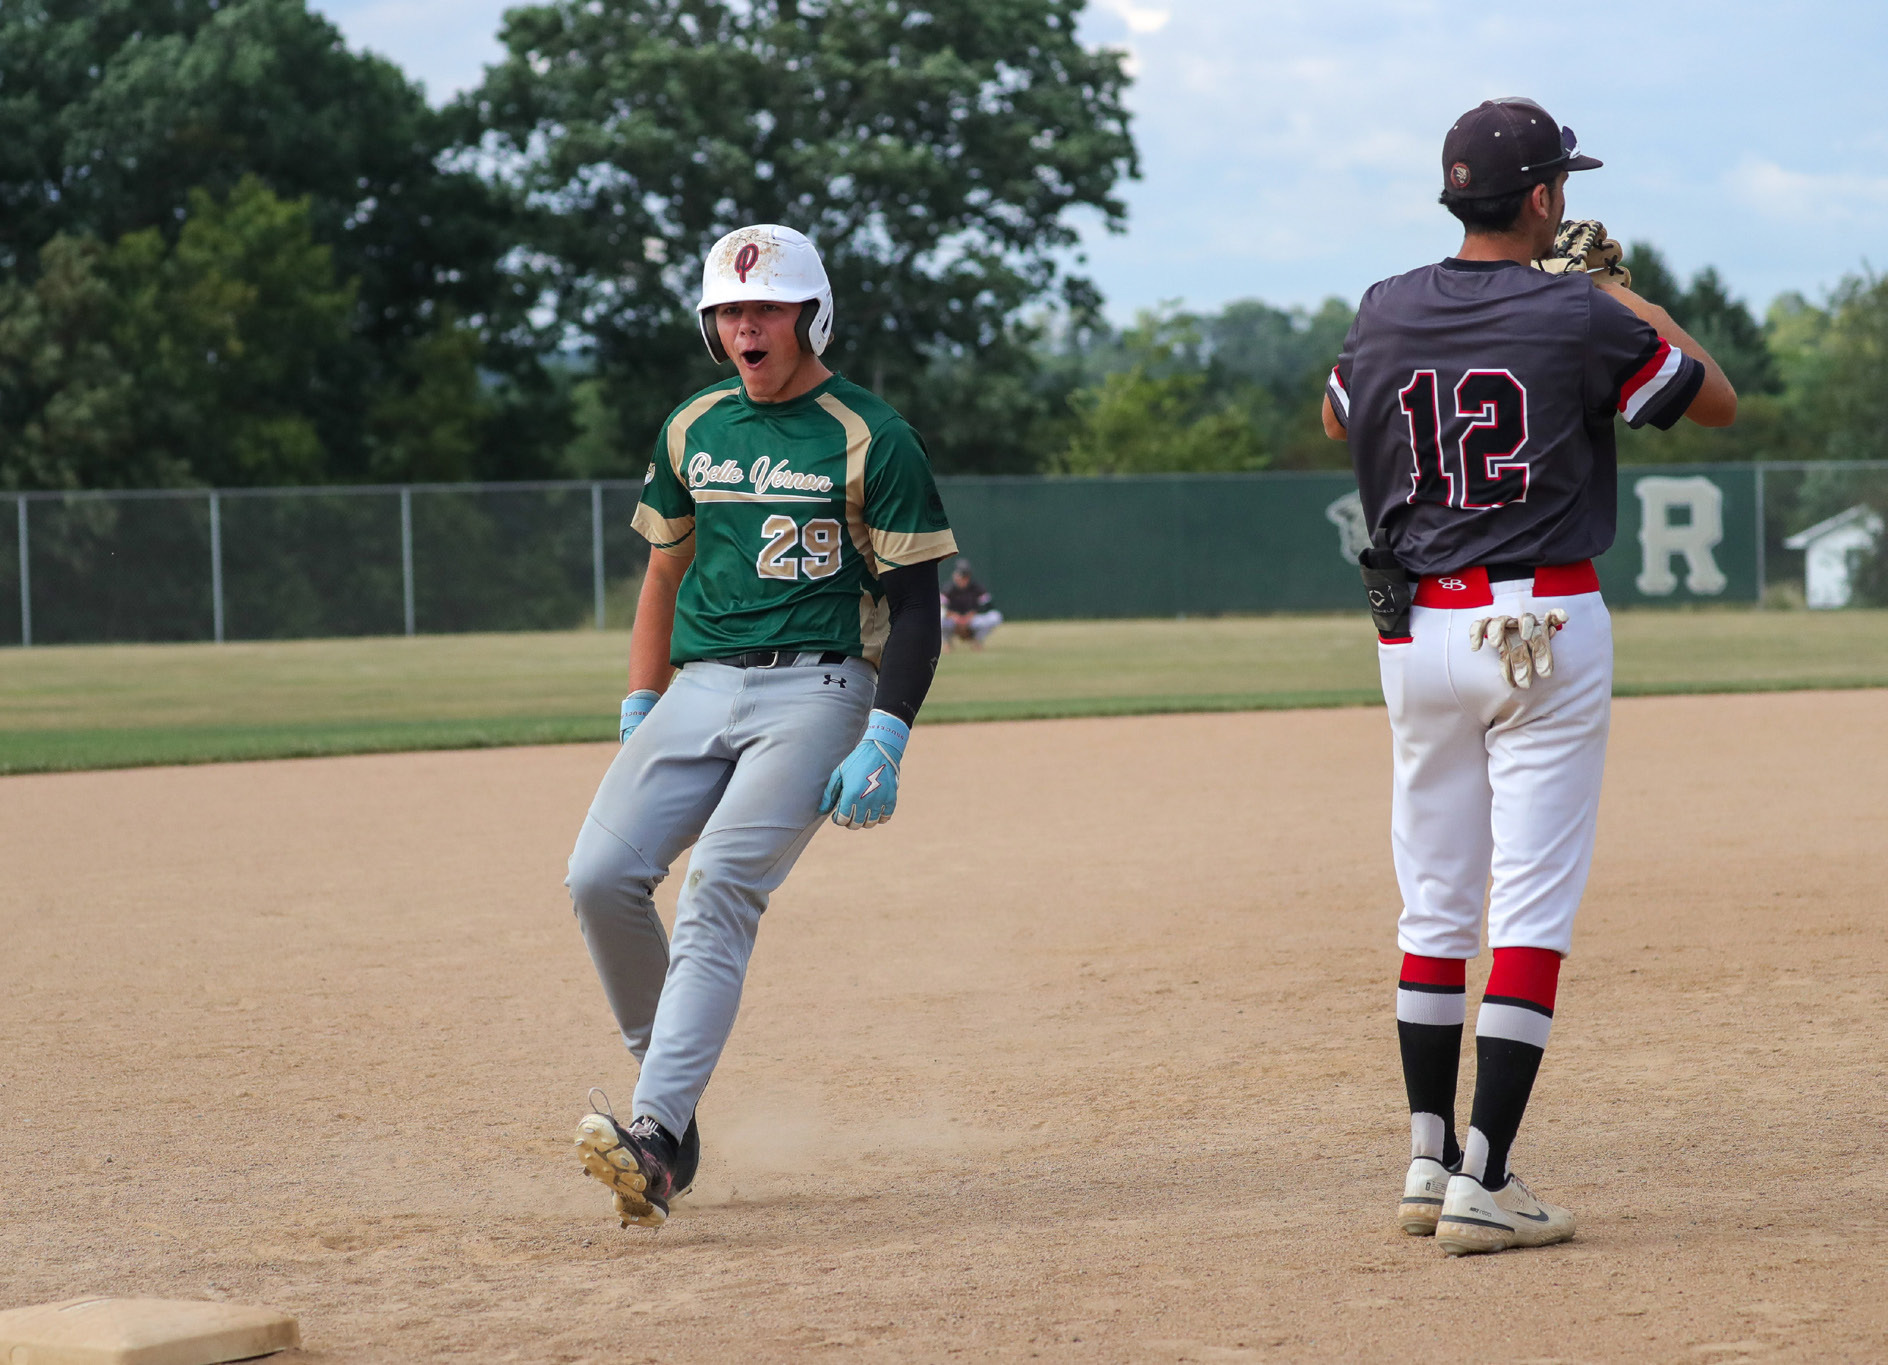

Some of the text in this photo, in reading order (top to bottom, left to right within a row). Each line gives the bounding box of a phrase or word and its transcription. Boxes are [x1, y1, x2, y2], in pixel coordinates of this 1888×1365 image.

[687, 451, 834, 495] Belle Vernon
[1398, 369, 1530, 509] 12
[755, 514, 844, 580] 29
[1633, 475, 1728, 597] R
